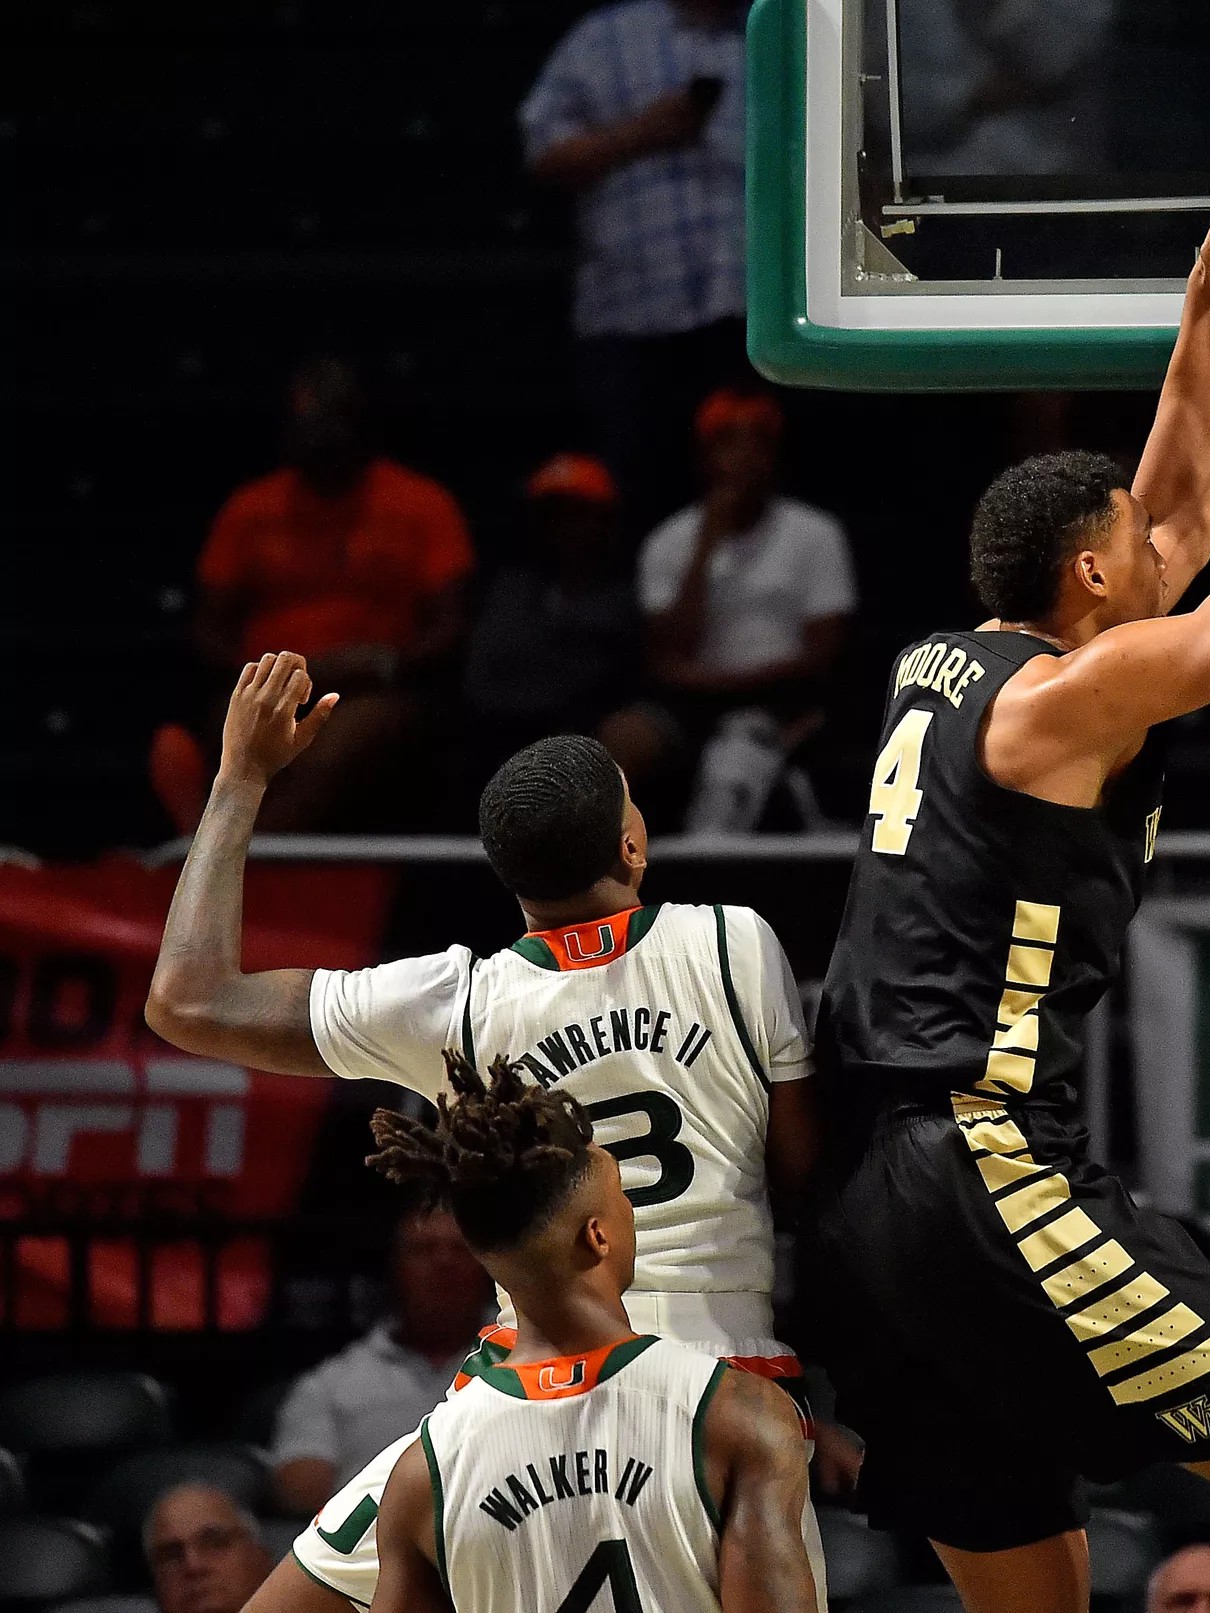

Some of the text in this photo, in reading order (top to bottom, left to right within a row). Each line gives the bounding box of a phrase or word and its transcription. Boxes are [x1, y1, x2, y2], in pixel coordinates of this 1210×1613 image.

[894, 642, 985, 709] MOORE
[868, 708, 934, 856] 4
[518, 1007, 712, 1089] AWRENCE II
[581, 1090, 695, 1207] 3
[479, 1449, 653, 1531] WALKER IV
